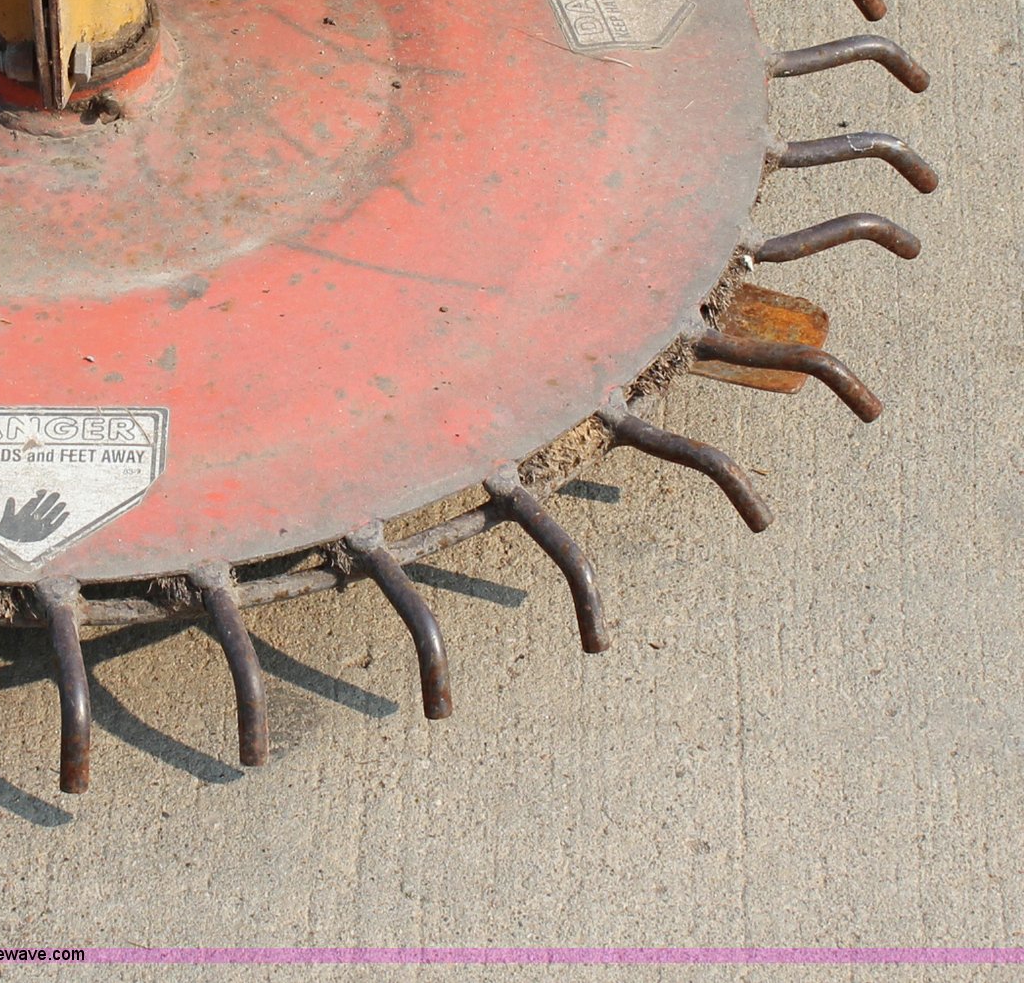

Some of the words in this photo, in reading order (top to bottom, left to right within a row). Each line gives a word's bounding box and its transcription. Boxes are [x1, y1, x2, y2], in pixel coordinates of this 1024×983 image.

[26, 448, 55, 464] and
[59, 448, 97, 464] FEET
[100, 448, 146, 465] AWAY
